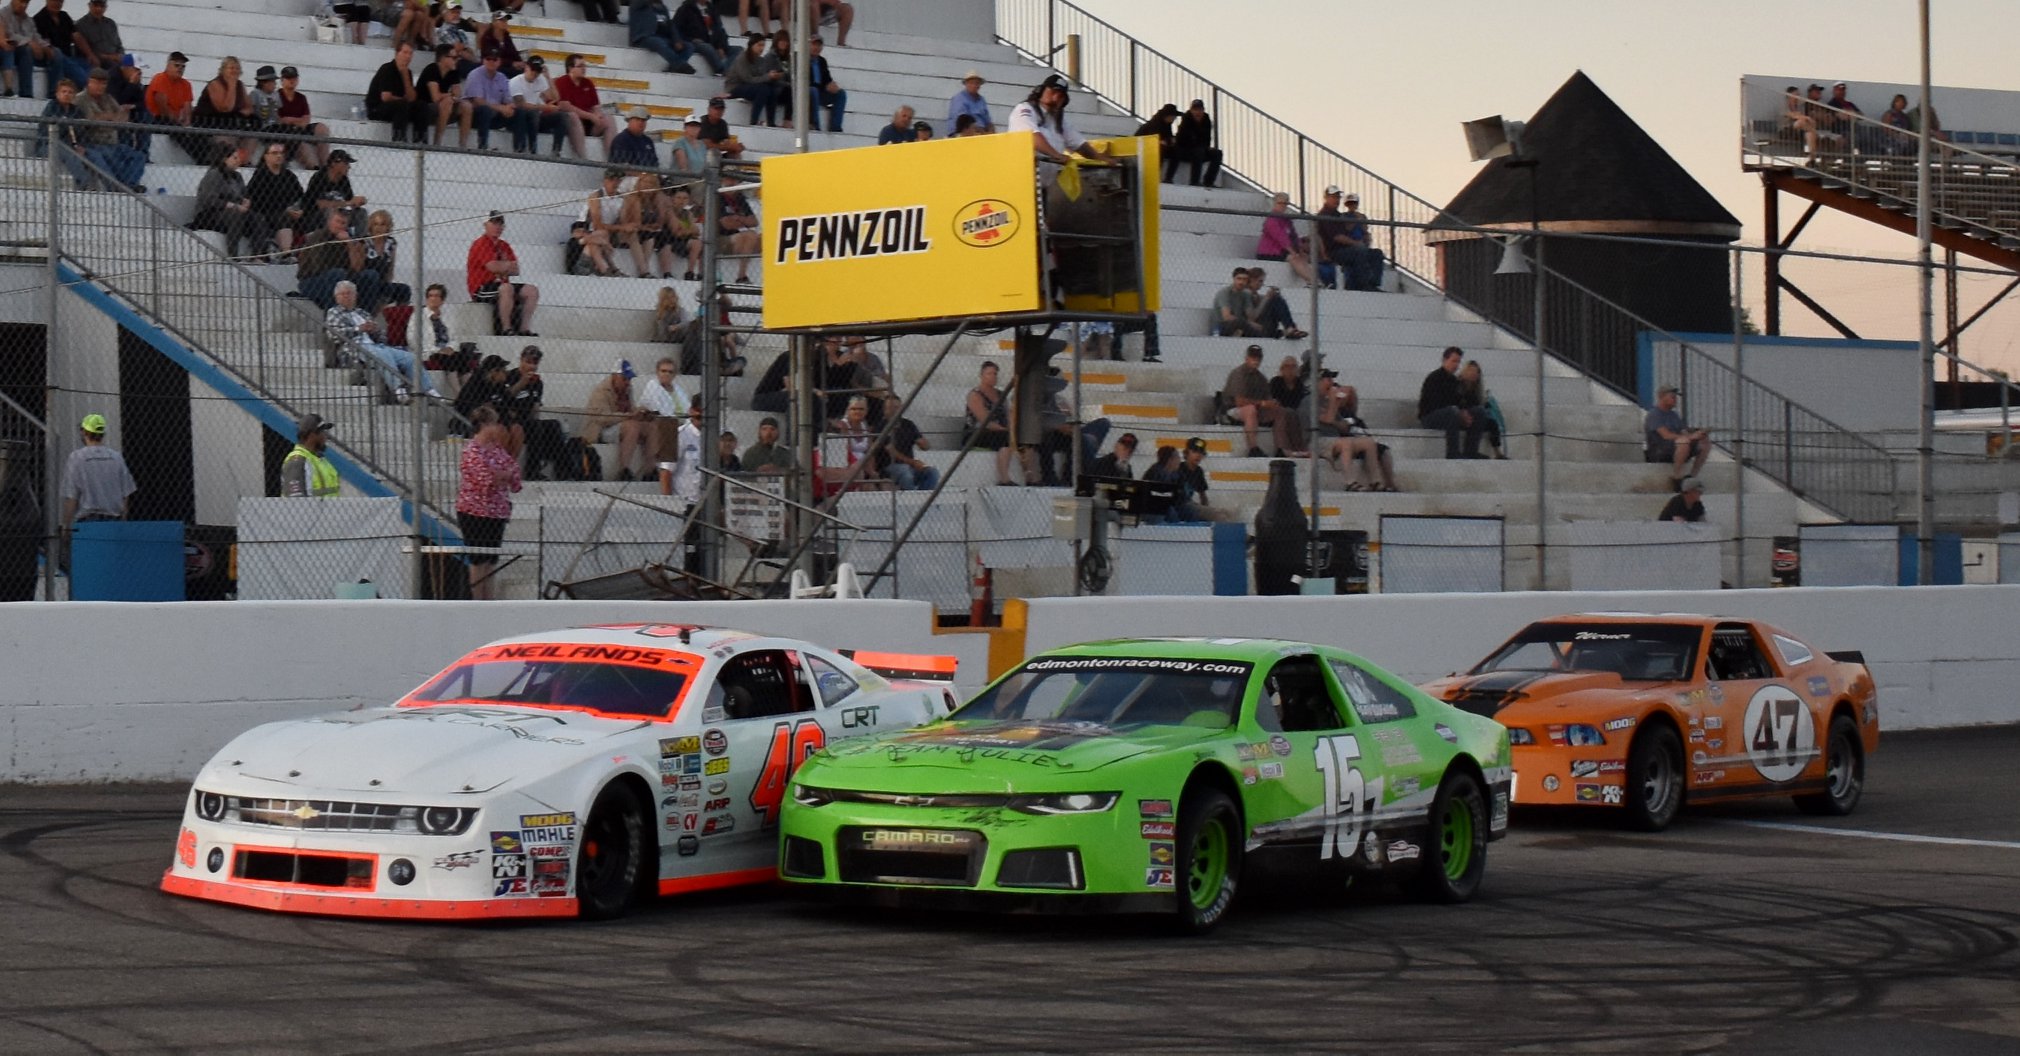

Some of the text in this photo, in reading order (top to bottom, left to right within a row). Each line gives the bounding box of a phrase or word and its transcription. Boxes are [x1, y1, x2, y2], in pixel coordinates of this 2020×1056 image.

[961, 211, 1012, 235] PENNZOIL
[776, 206, 931, 264] PENNZOIL
[495, 646, 665, 665] NEILANDS
[1026, 658, 1246, 675] edmontonraceway.com
[841, 705, 880, 729] CRT
[1605, 717, 1636, 730] MOOG
[1751, 699, 1800, 767] 47
[1313, 733, 1361, 860] 15
[521, 827, 574, 842] MAHLE
[862, 831, 955, 844] CAMARO
[494, 878, 527, 897] JE
[1146, 870, 1174, 886] JE
